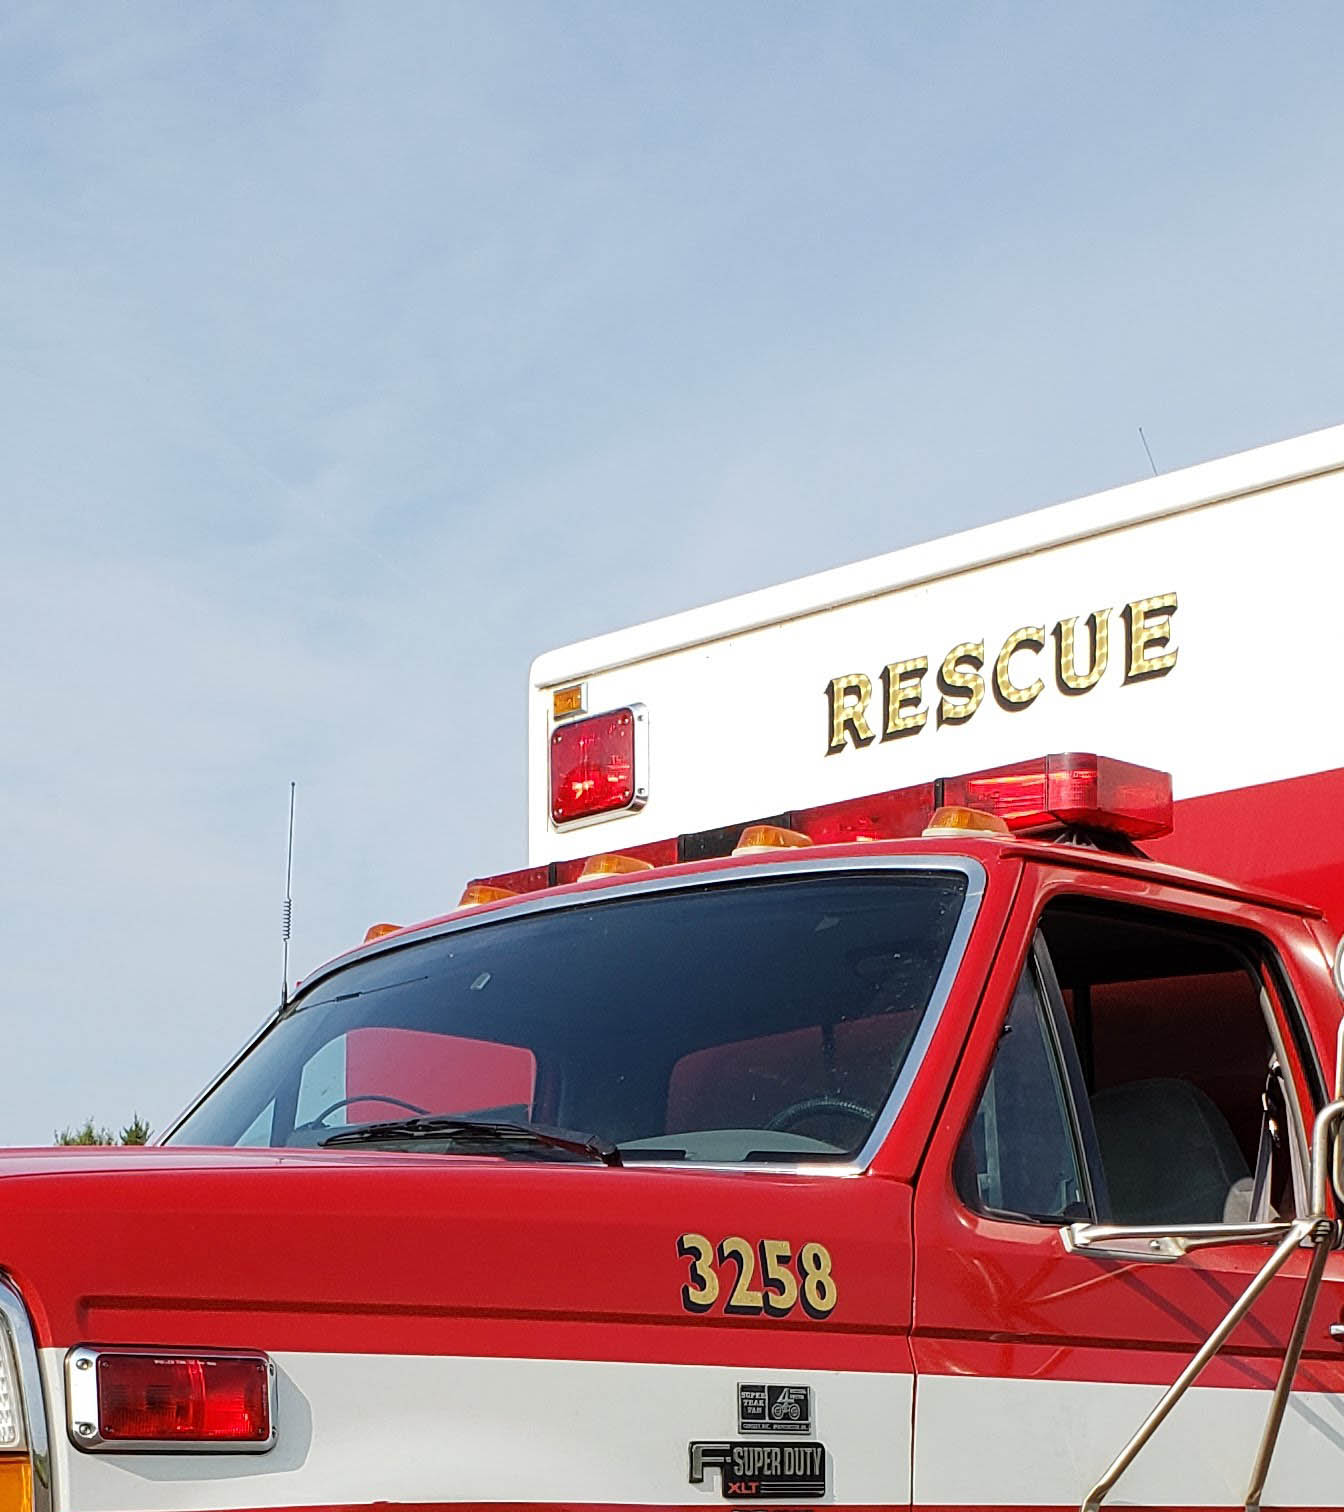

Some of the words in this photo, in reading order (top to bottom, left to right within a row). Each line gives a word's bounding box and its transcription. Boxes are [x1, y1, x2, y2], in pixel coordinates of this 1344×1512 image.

[824, 591, 1179, 757] RESCUE
[676, 1233, 838, 1320] 3258
[728, 1482, 760, 1494] XLT
[733, 1447, 781, 1476] SUPER
[784, 1447, 822, 1476] DUTY
